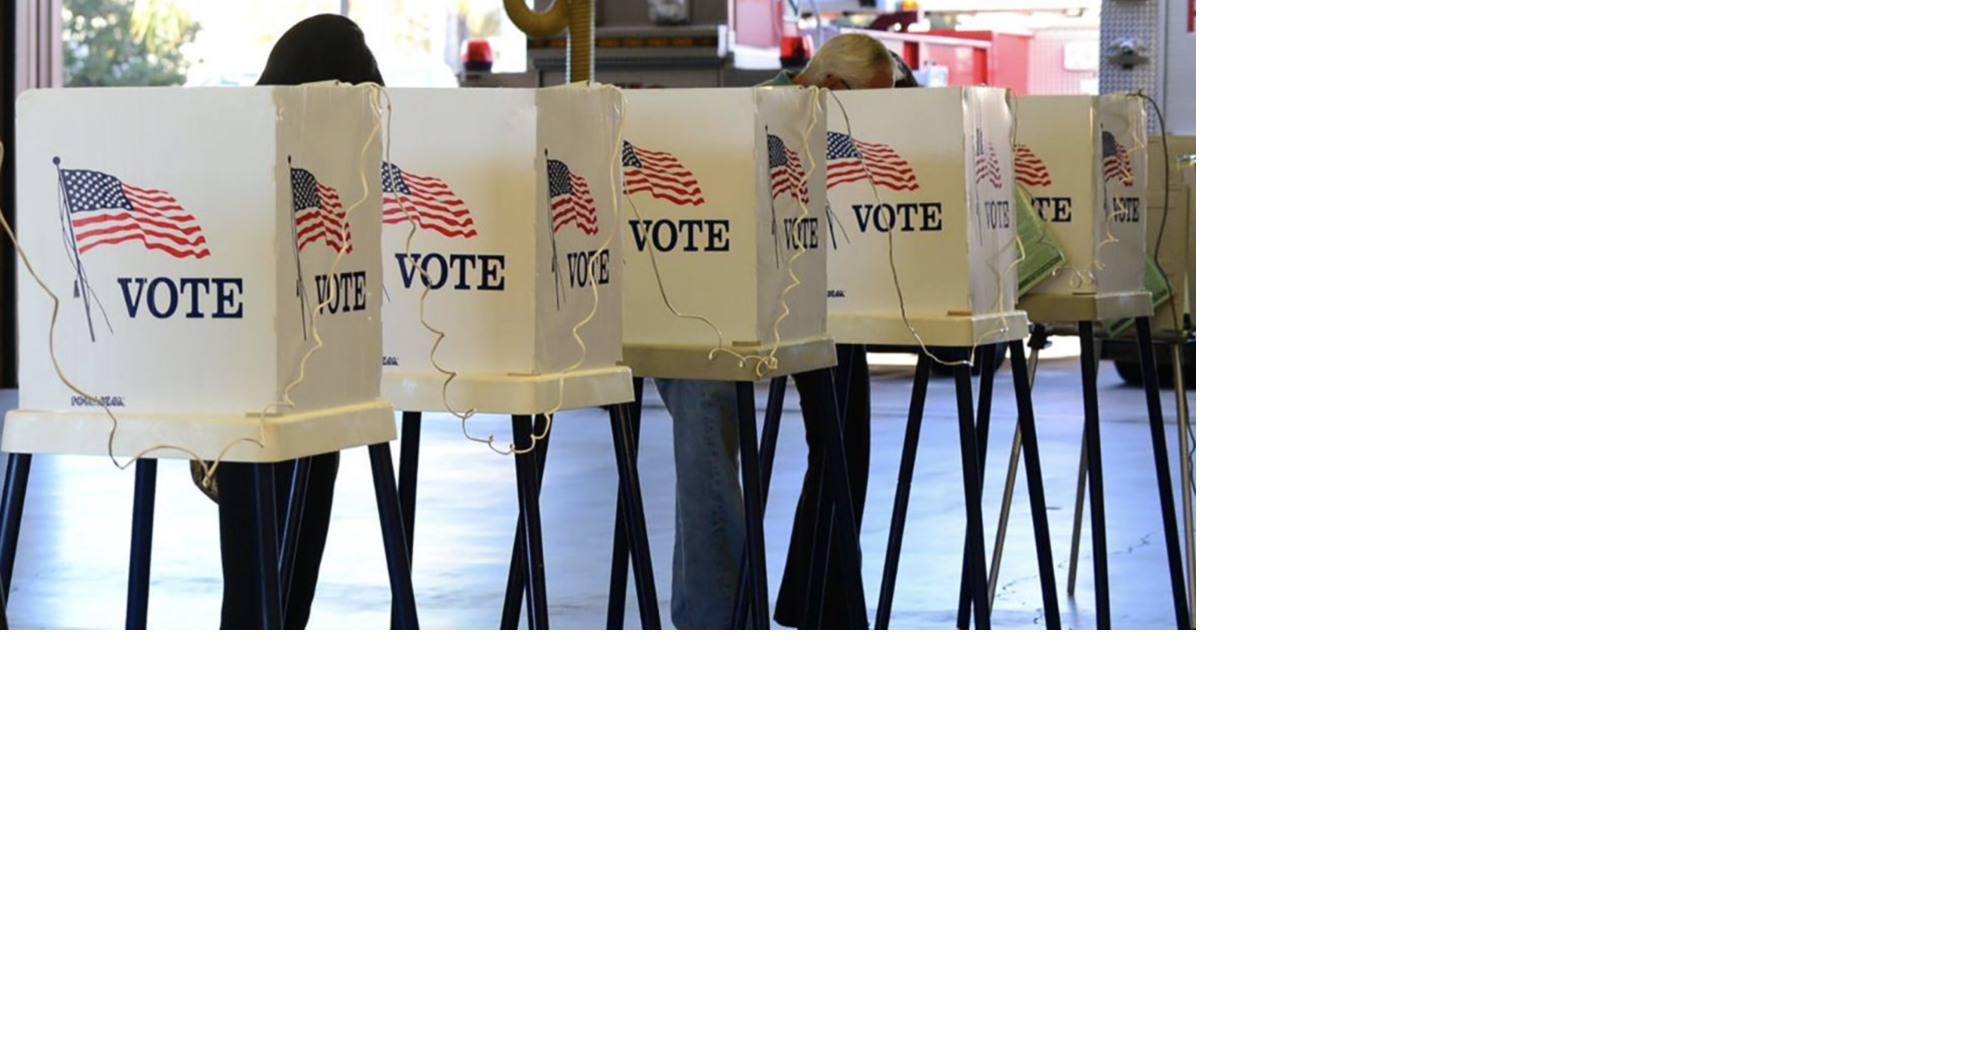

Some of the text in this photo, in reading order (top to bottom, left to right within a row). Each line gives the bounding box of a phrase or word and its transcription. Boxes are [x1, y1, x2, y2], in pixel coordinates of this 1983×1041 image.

[852, 203, 943, 232] VOTE
[984, 200, 1010, 229] VOTE
[1031, 197, 1072, 222] TE
[1113, 197, 1140, 222] VOTE
[629, 219, 729, 252] VOTE
[783, 217, 819, 250] VOTE
[395, 253, 505, 291] VOTE
[567, 249, 610, 288] VOTE
[117, 277, 243, 319] VOTE
[315, 271, 366, 316] VOTE
